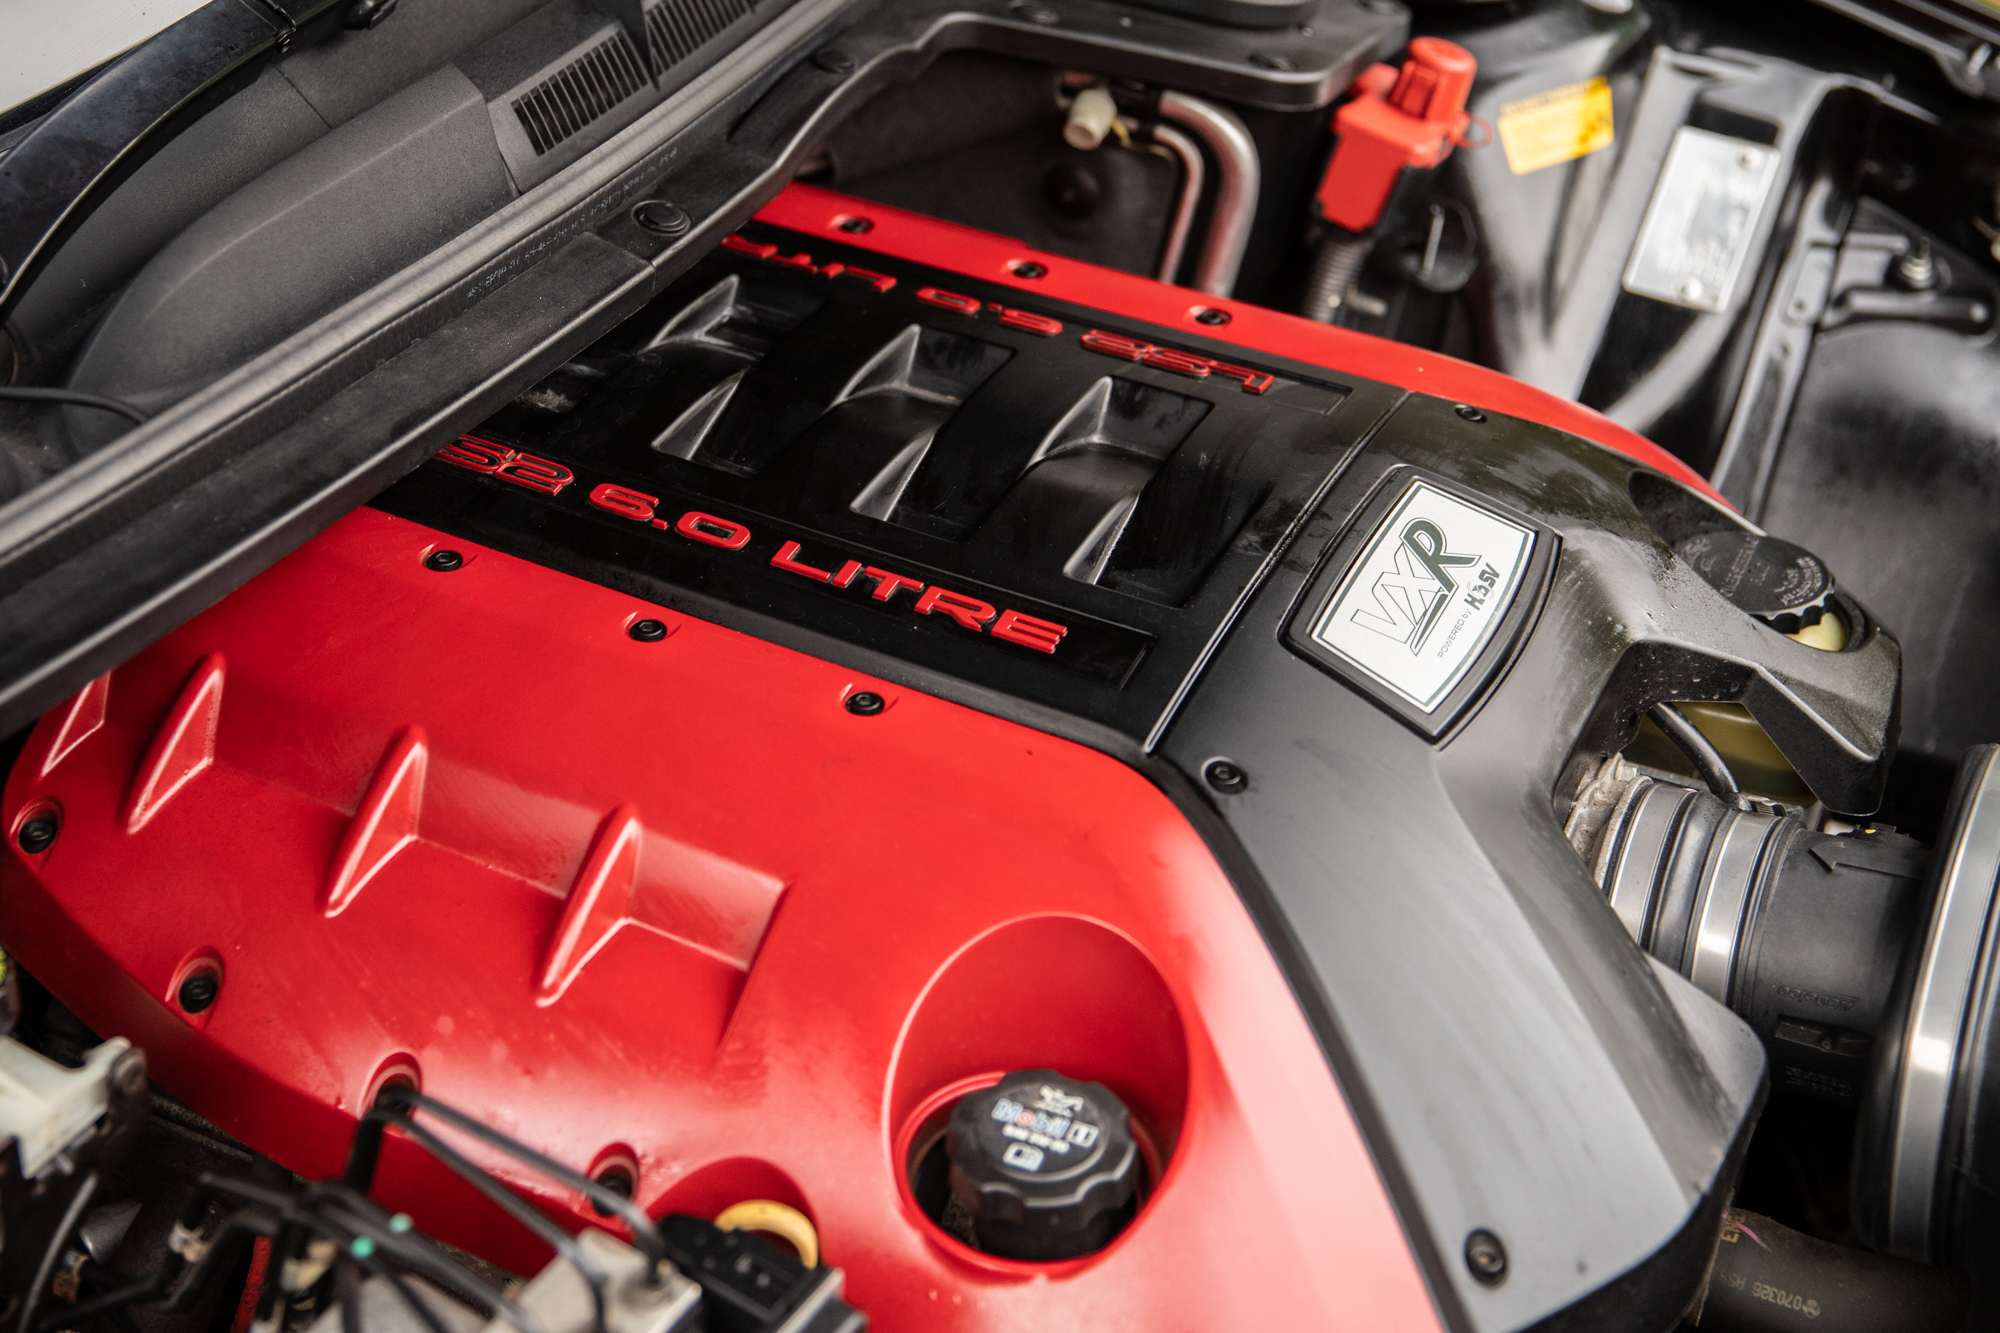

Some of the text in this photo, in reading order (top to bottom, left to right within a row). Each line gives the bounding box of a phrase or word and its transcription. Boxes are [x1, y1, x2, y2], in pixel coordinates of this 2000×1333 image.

[721, 234, 1275, 395] LS2 6.0 LITR
[434, 434, 1069, 655] S2 6.0 LITRE
[1350, 517, 1483, 656] VXR
[1437, 618, 1465, 658] POWERED
[1460, 608, 1472, 620] by
[1778, 986, 1857, 1012] ACDelco
[991, 1098, 1071, 1139] Mobil
[1752, 1281, 1802, 1311] 070326
